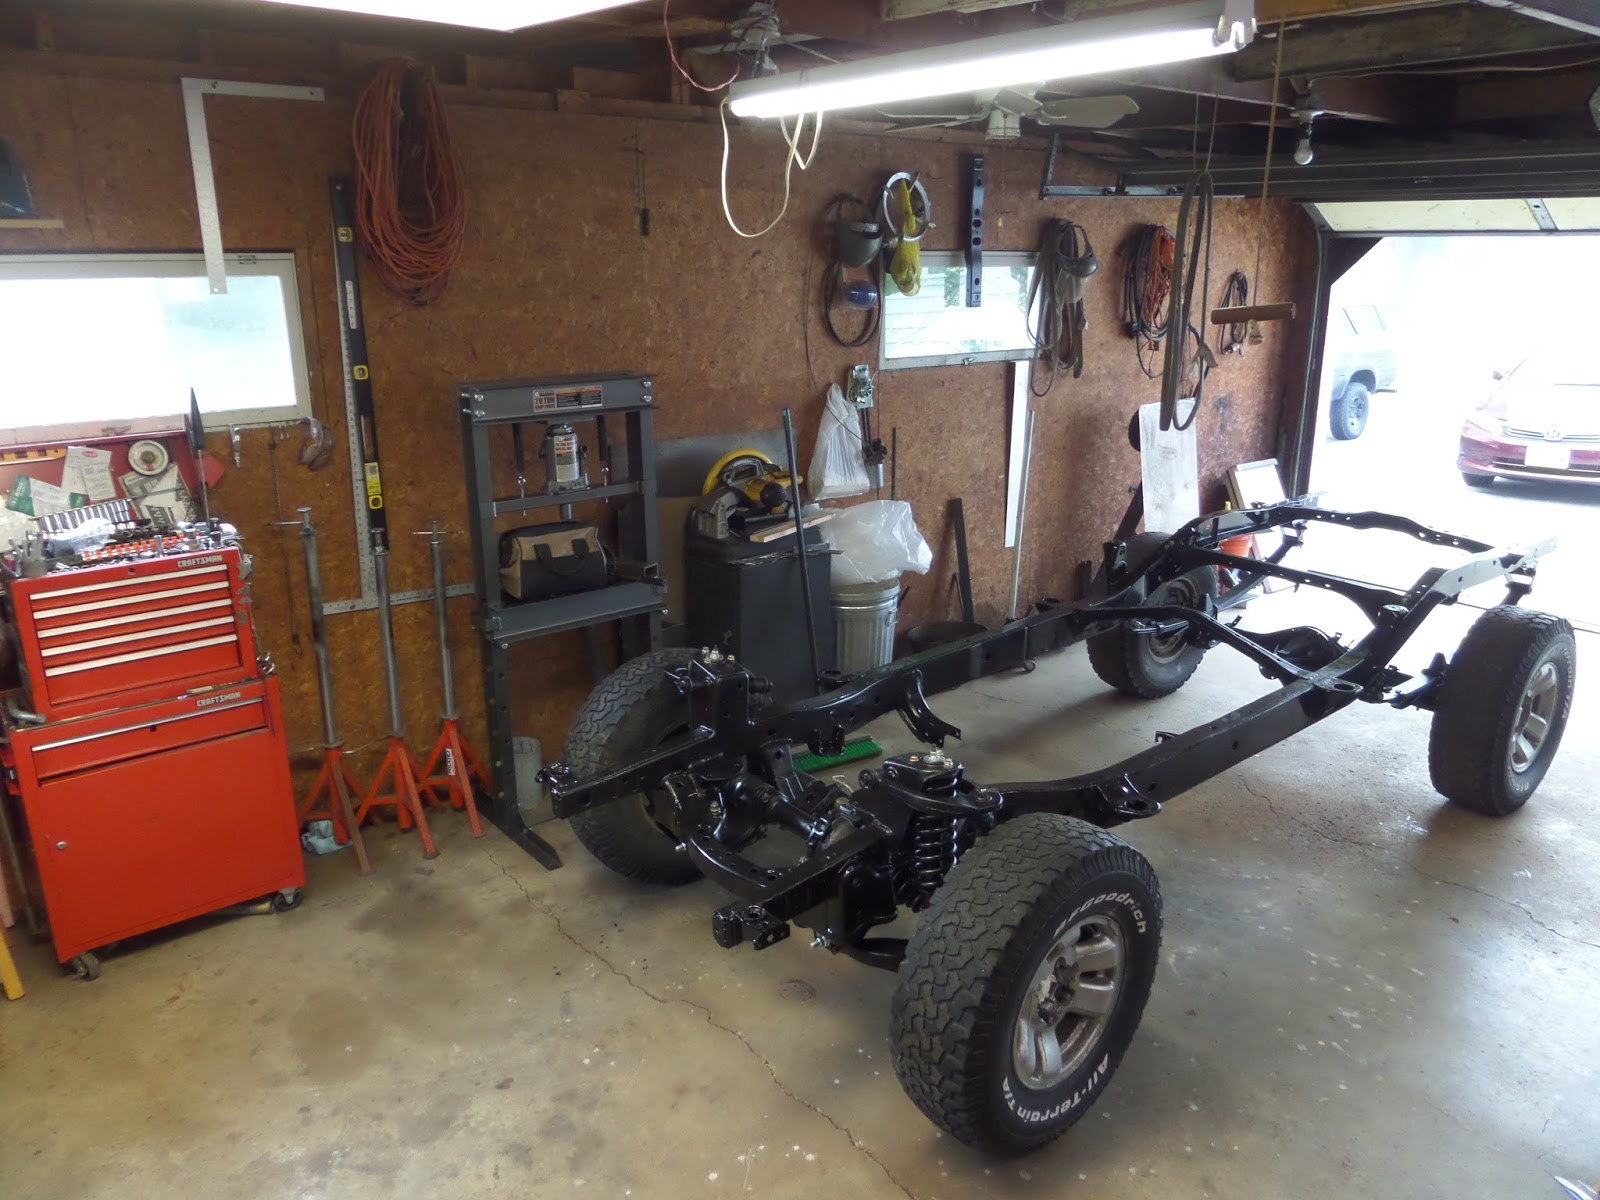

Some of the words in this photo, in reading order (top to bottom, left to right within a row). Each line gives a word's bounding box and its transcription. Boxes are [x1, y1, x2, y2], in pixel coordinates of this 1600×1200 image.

[535, 397, 543, 405] 20
[544, 396, 555, 404] TON
[177, 554, 222, 568] CRAFTSMAN
[197, 691, 241, 707] CRAFTSMAN
[1053, 892, 1147, 939] BFGoodrich
